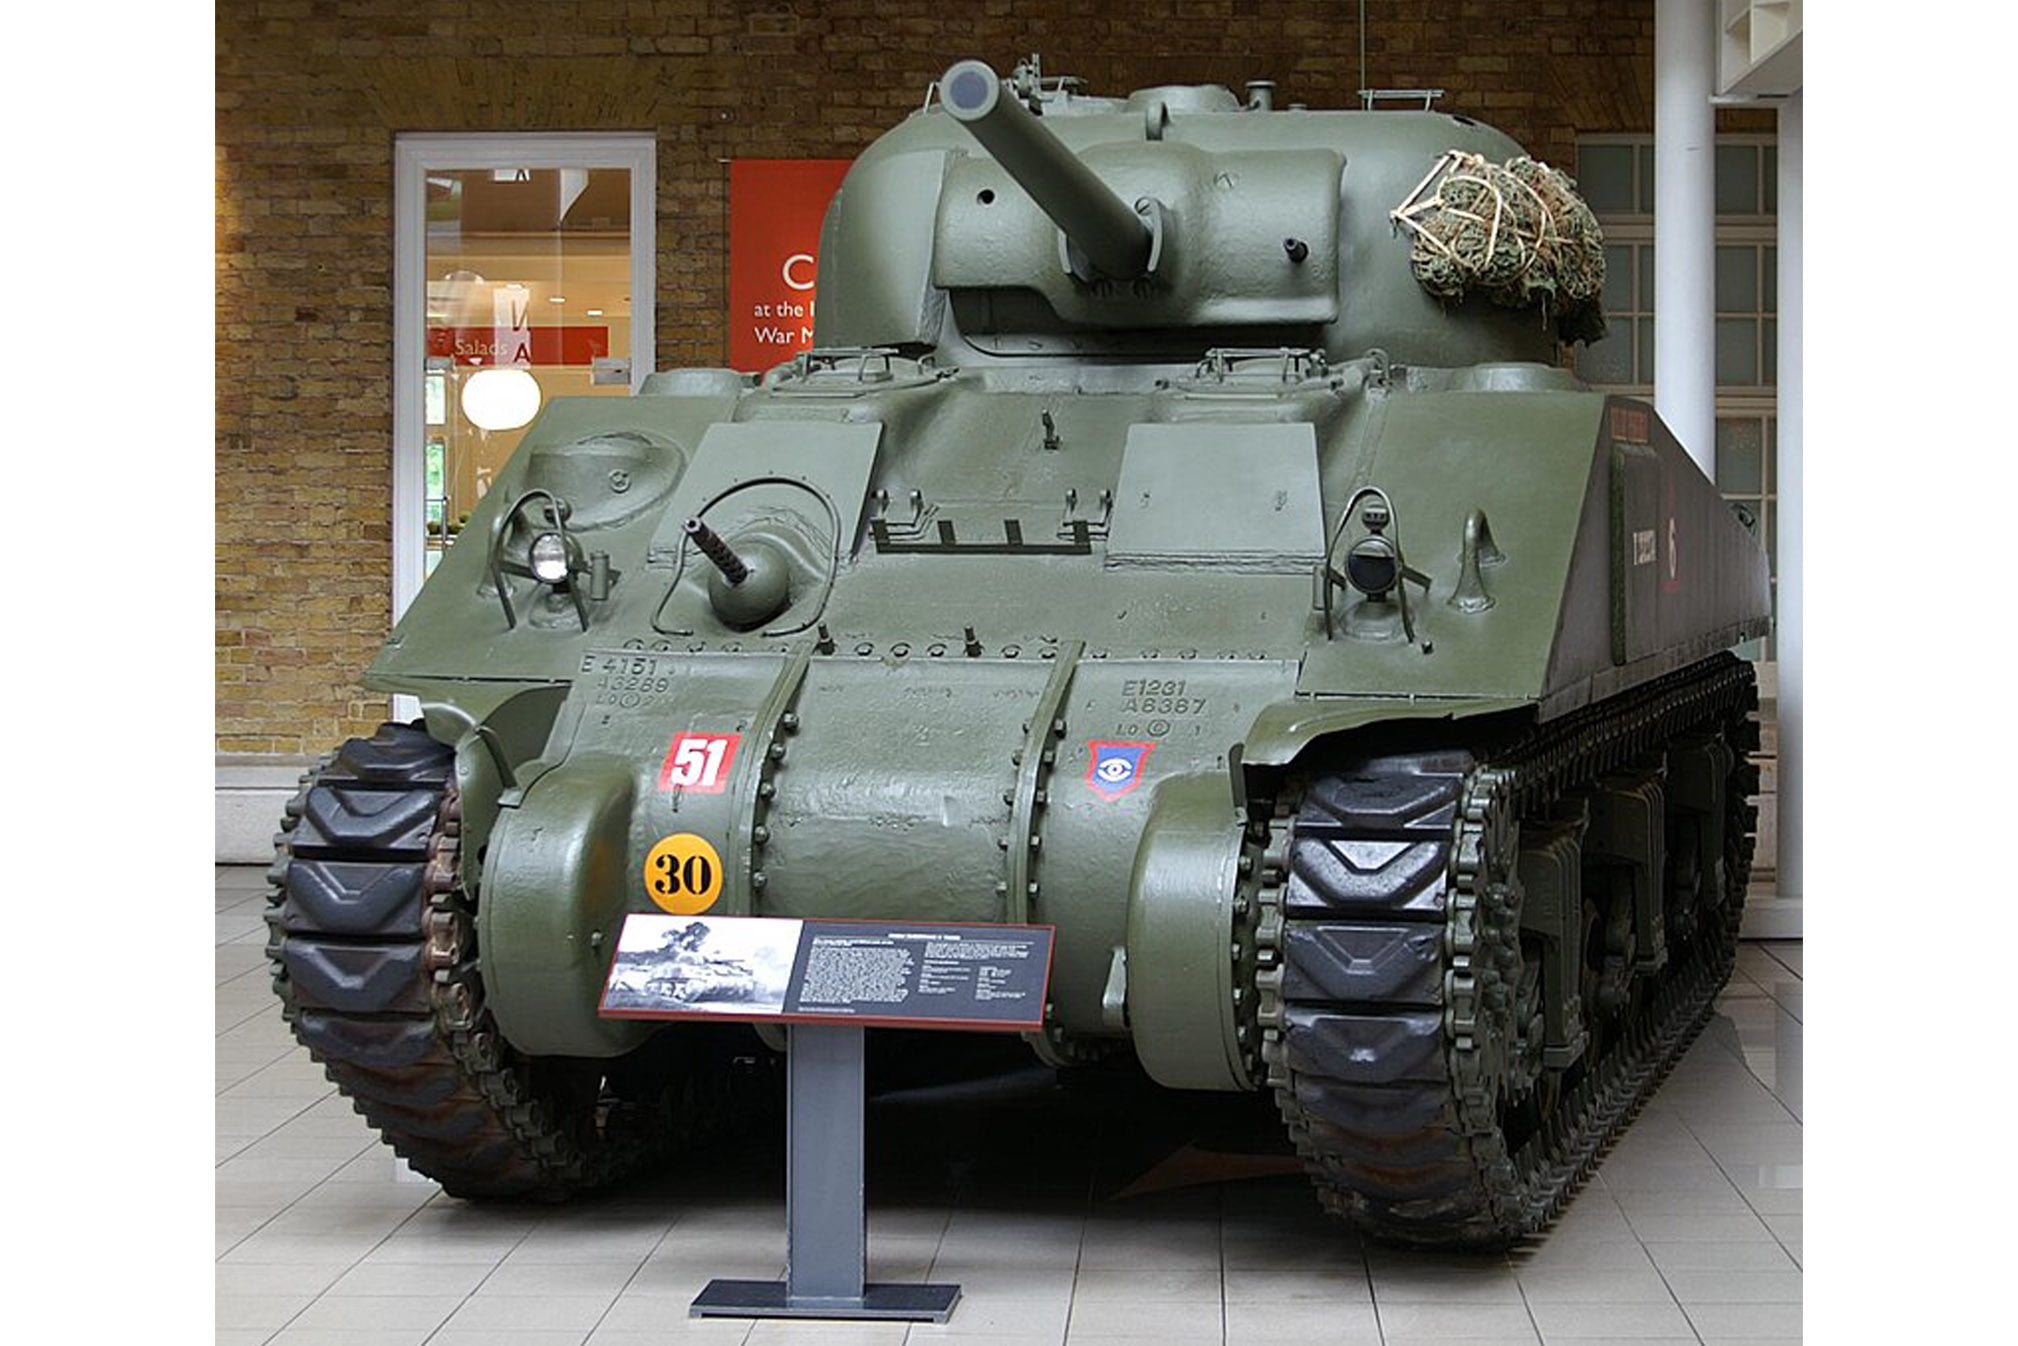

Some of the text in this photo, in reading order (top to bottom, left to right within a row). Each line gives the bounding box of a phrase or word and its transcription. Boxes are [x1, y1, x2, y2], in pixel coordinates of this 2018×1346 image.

[754, 305, 771, 317] at
[777, 301, 804, 317] the
[754, 327, 795, 344] War
[582, 655, 596, 672] E
[671, 738, 729, 787] 51
[654, 854, 712, 895] 30
